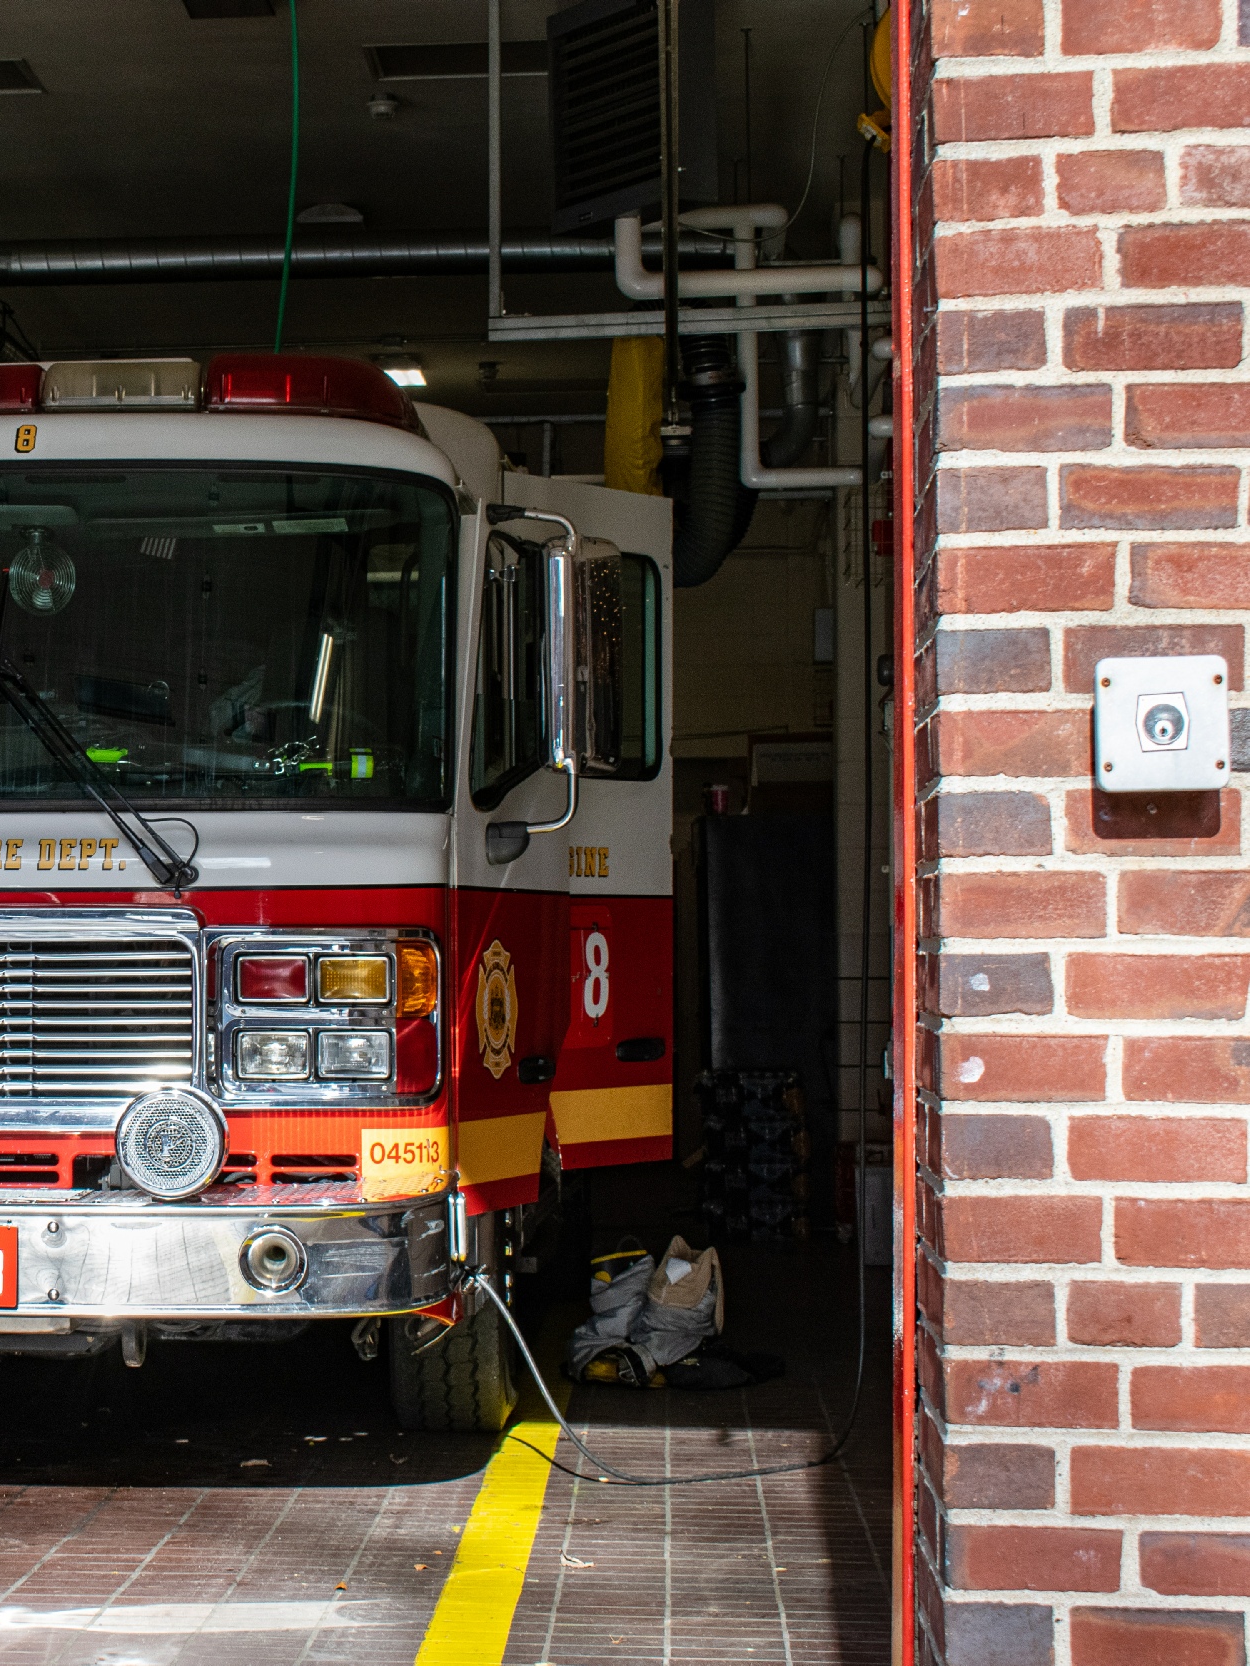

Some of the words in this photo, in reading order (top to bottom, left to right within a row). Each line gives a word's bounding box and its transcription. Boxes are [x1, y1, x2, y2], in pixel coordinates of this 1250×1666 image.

[14, 424, 38, 453] 8
[37, 837, 127, 870] DEPT.
[584, 931, 610, 1018] 8
[370, 1140, 440, 1165] 045113
